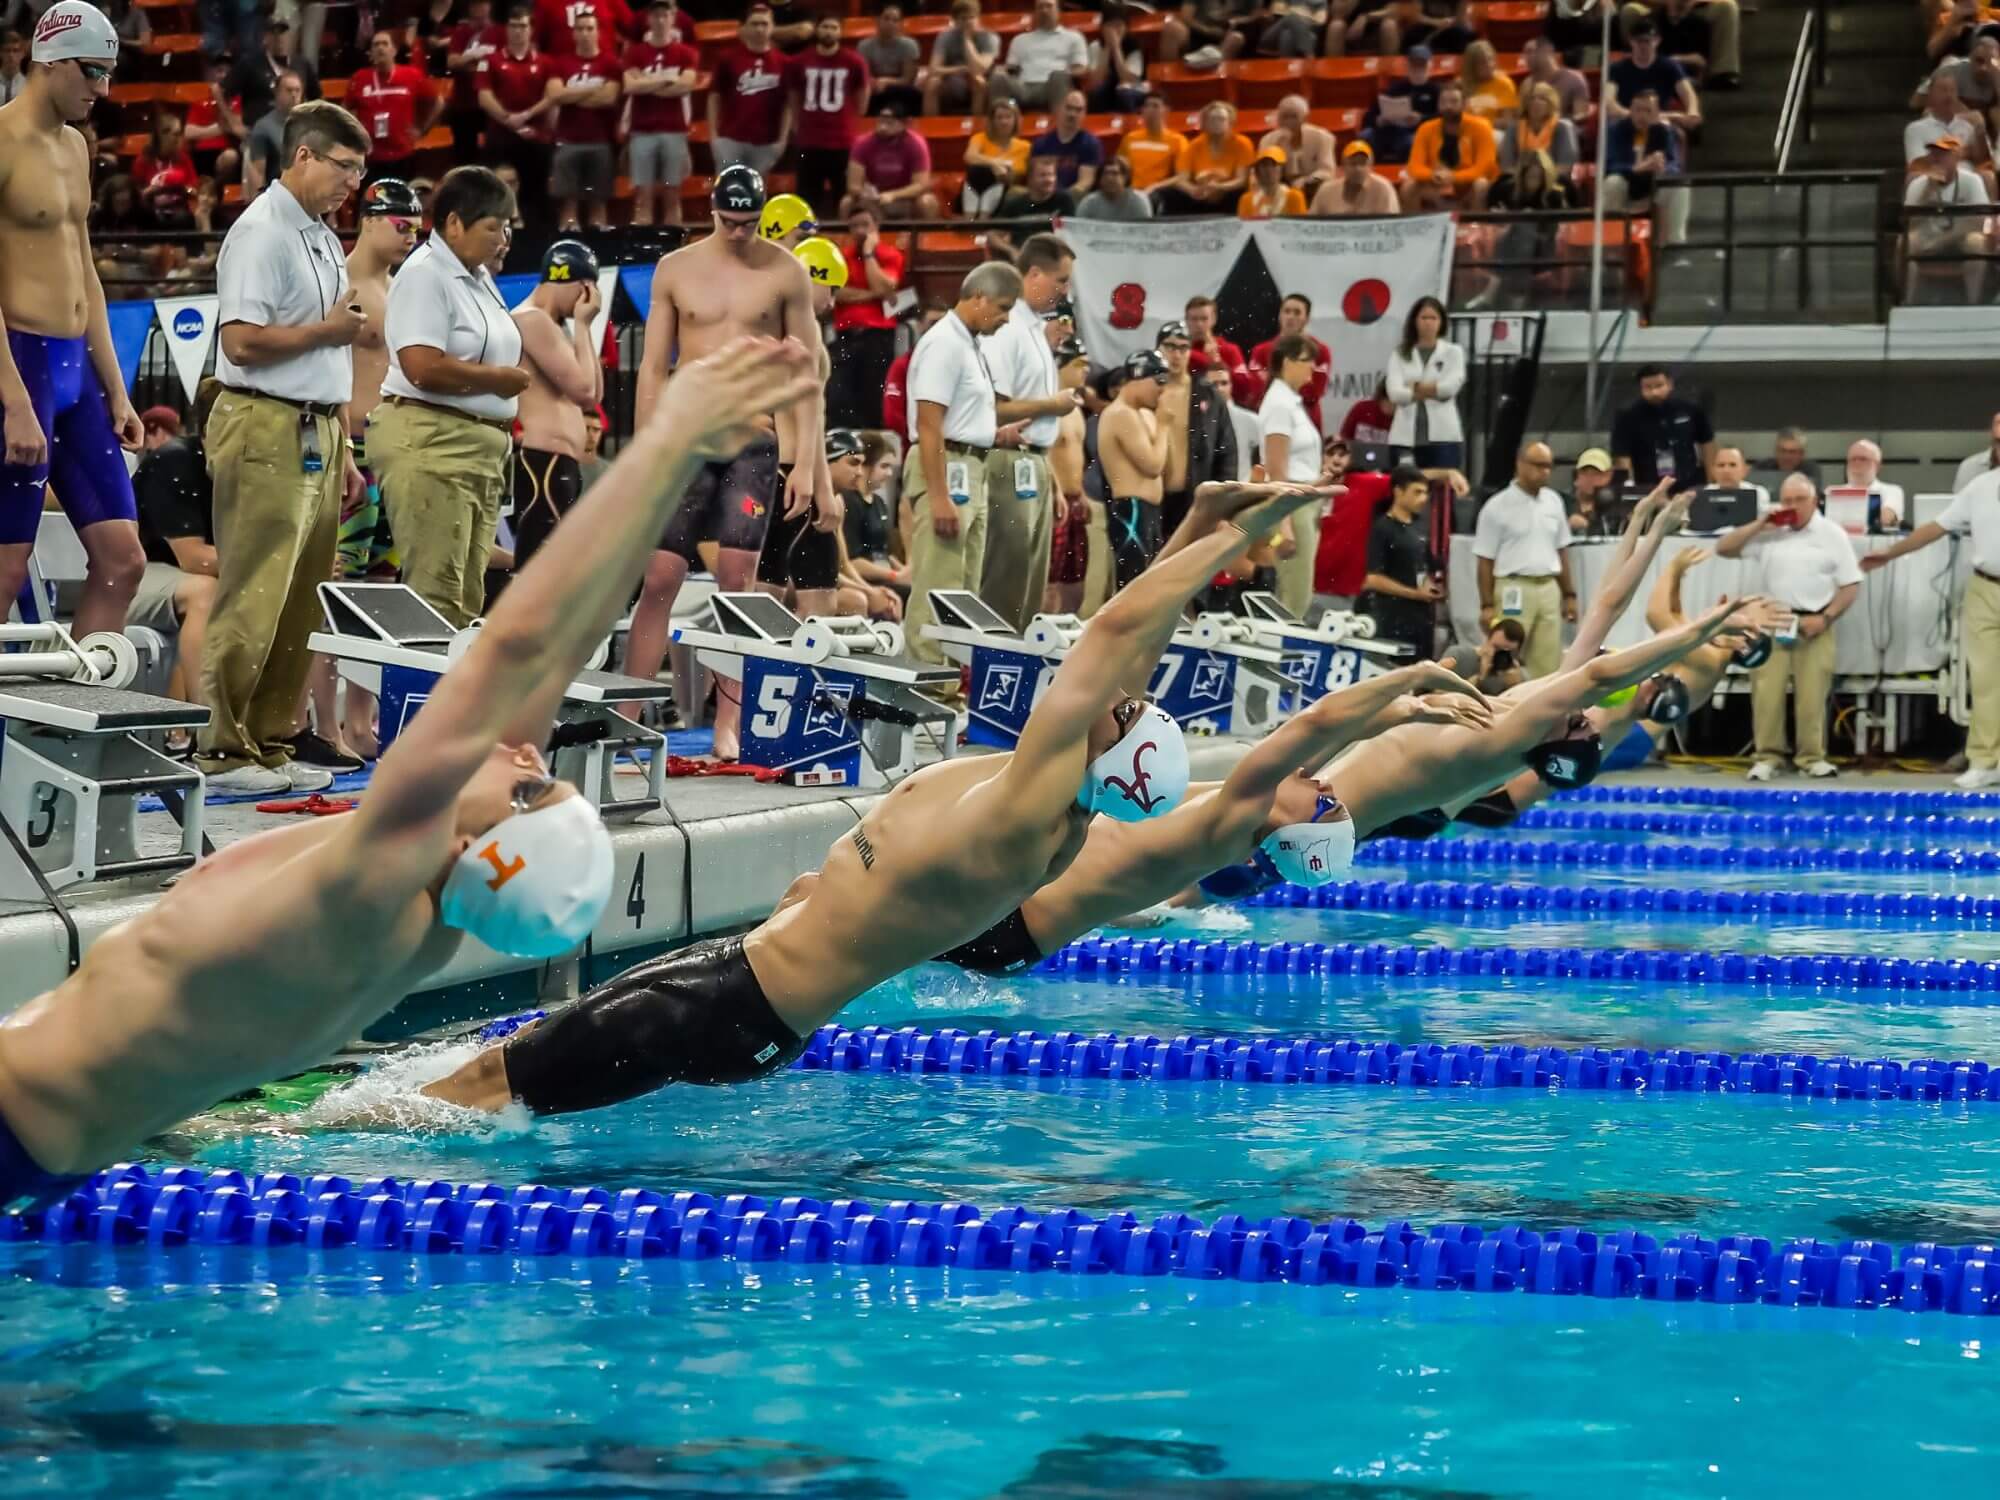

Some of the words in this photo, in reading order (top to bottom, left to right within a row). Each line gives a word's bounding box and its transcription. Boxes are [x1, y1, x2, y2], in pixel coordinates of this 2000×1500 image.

[804, 68, 848, 112] IU
[729, 197, 752, 207] TYR
[549, 264, 570, 281] M
[809, 265, 828, 280] M
[176, 321, 204, 334] NCAA
[1152, 653, 1184, 699] 7
[1325, 650, 1357, 691] 8
[750, 674, 799, 739] 5
[27, 783, 60, 849] 3
[626, 851, 645, 930] 4
